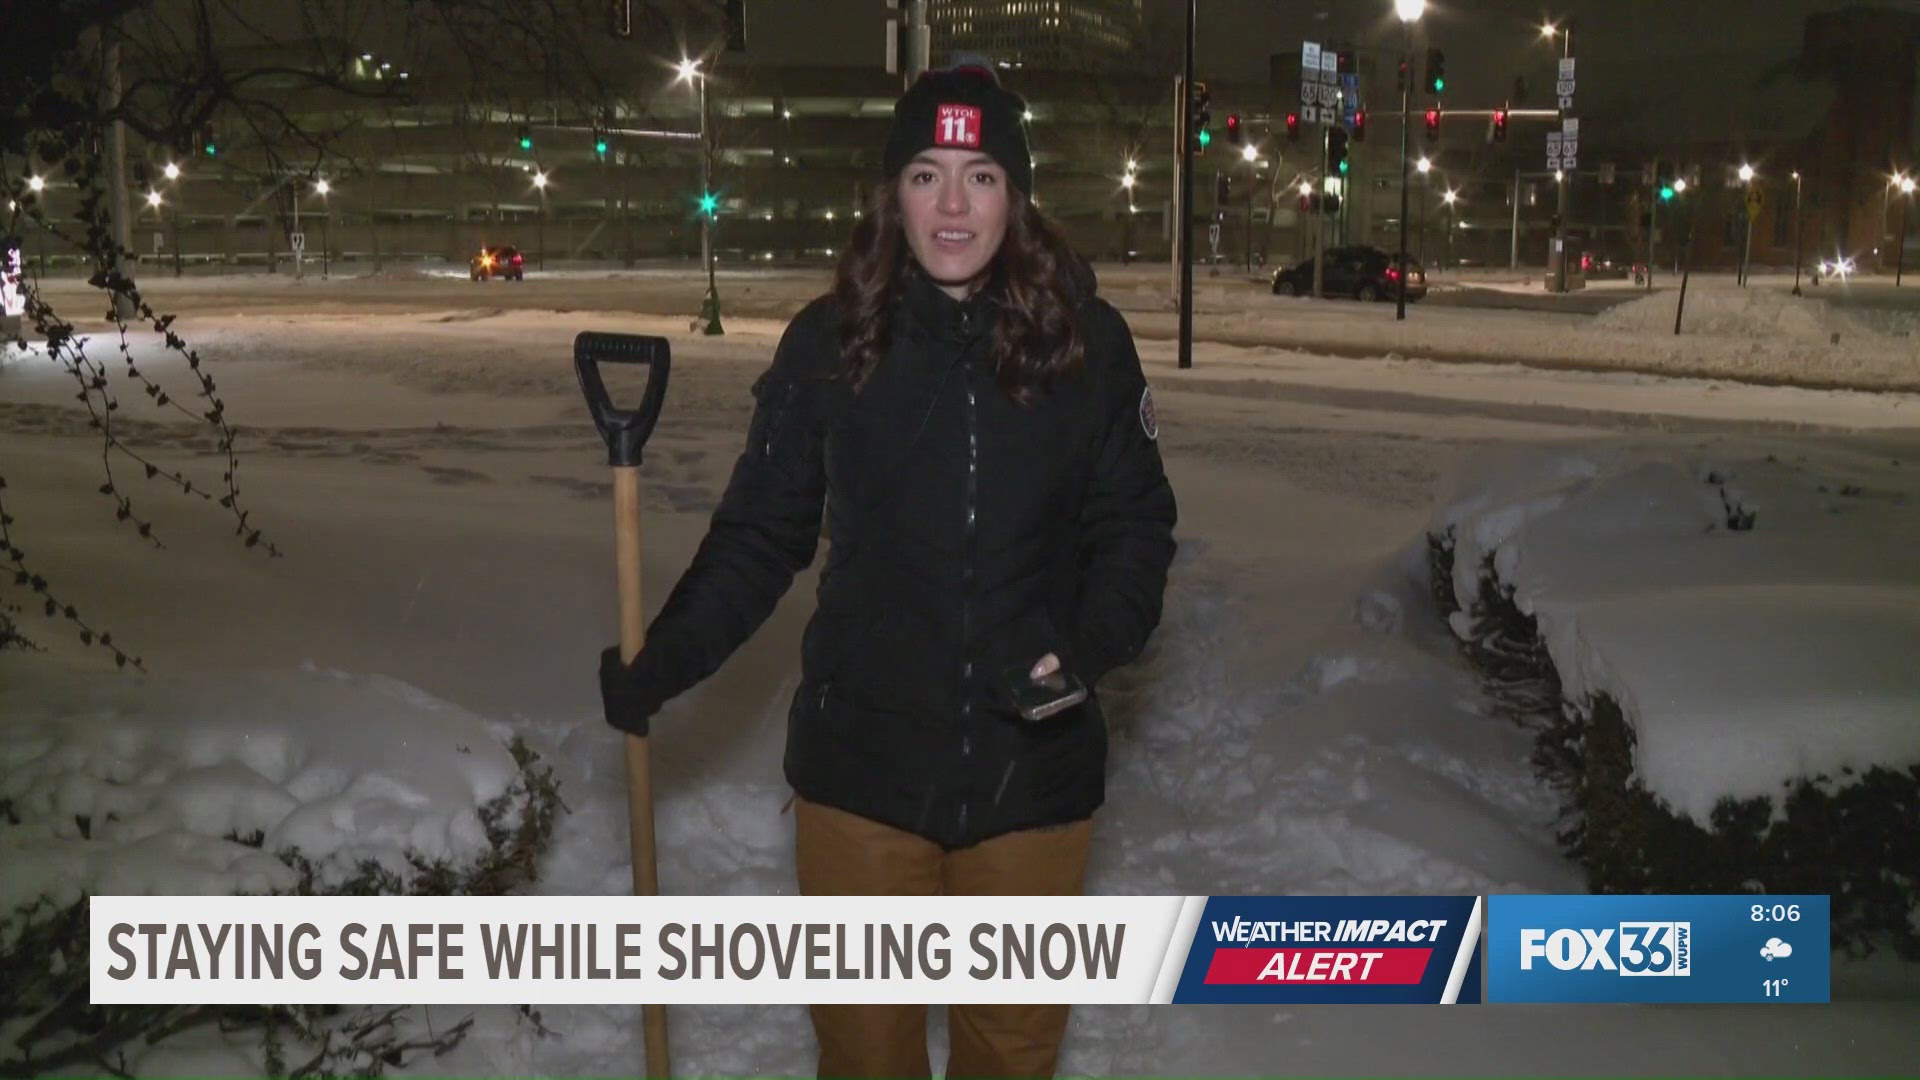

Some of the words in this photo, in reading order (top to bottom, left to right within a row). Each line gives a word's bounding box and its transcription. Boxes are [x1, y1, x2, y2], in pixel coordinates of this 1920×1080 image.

[1303, 86, 1315, 99] 65
[941, 107, 976, 119] WTOL
[941, 116, 966, 143] 11
